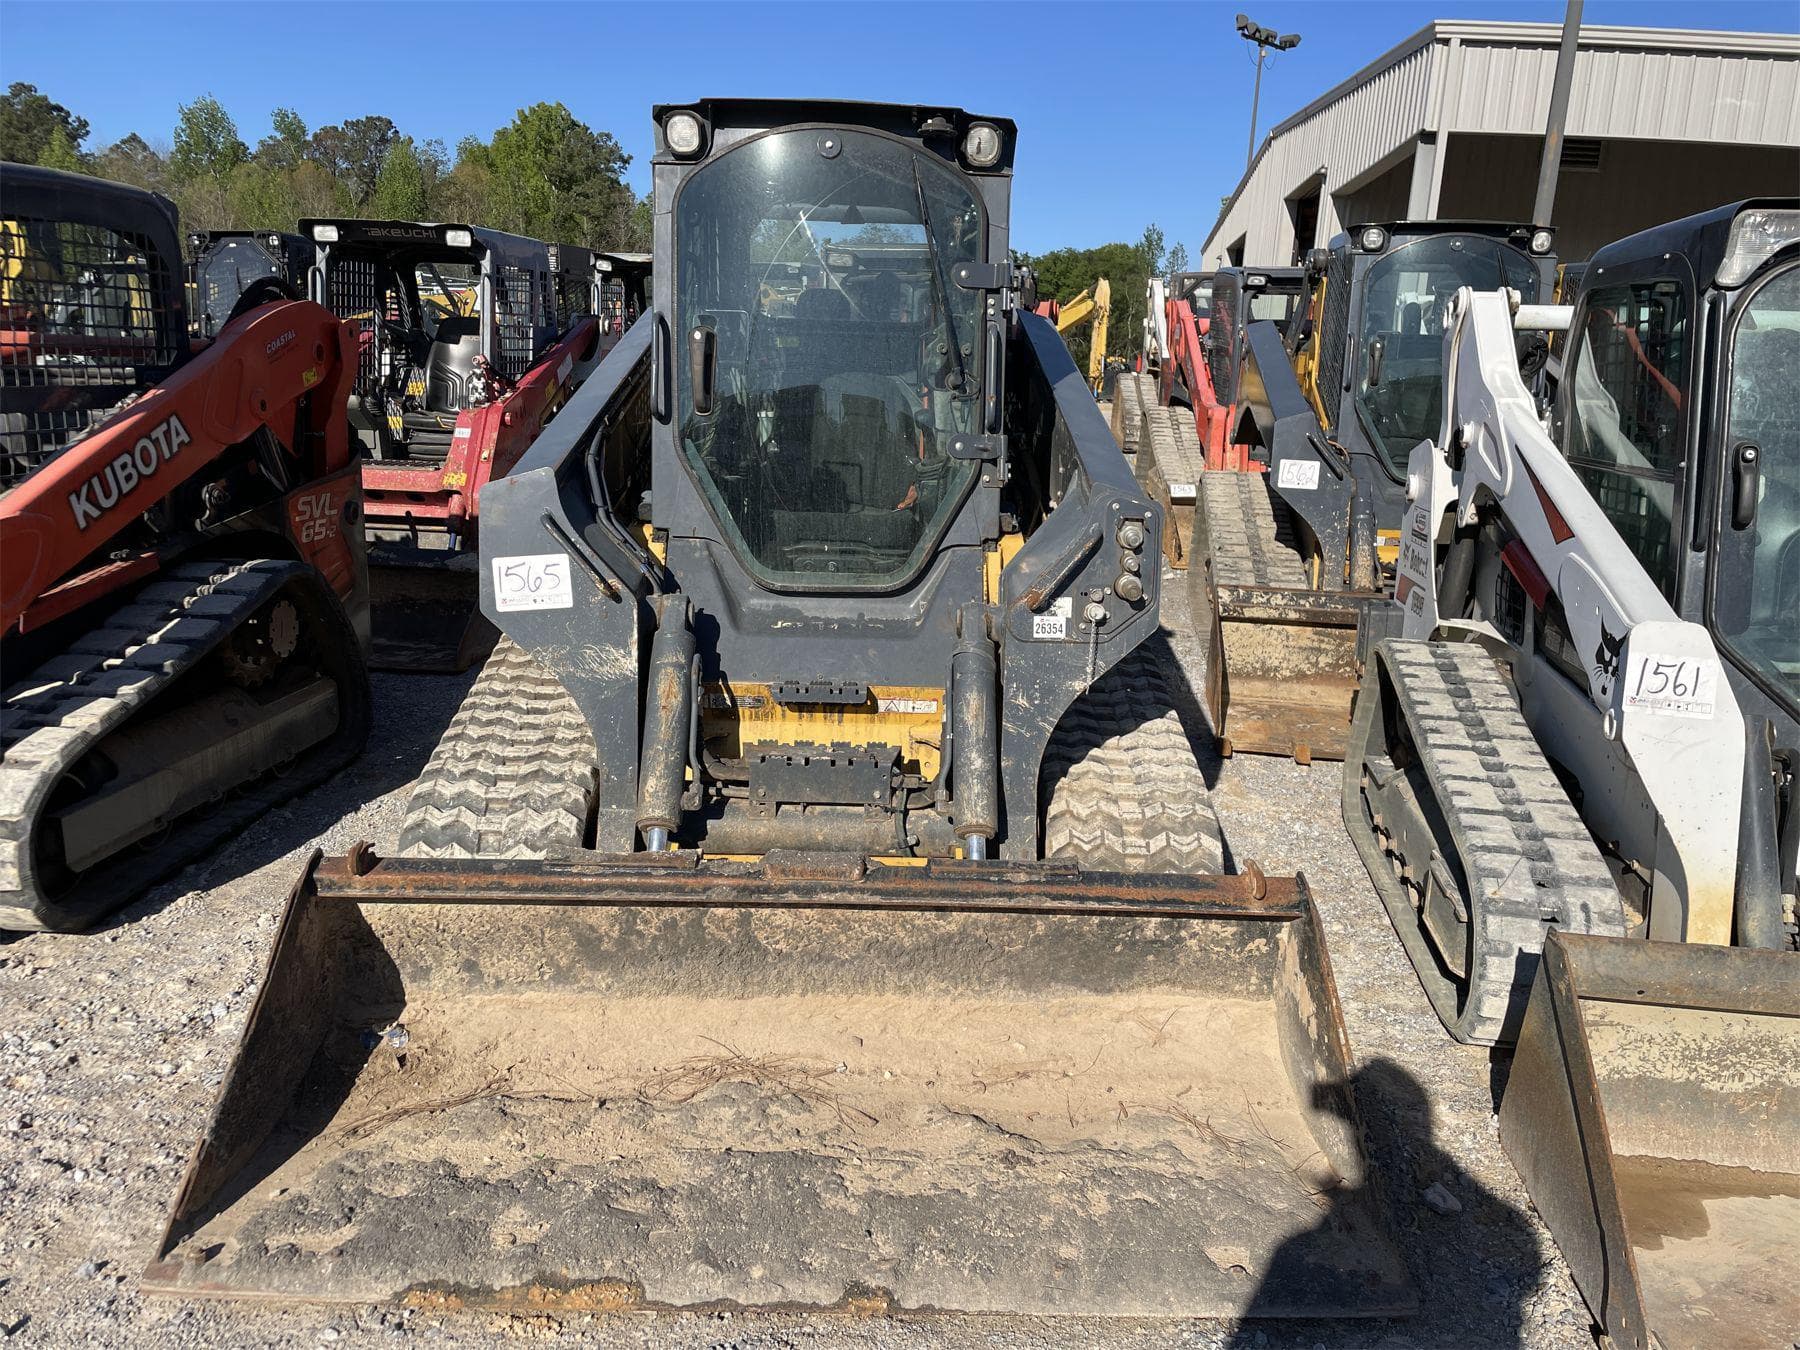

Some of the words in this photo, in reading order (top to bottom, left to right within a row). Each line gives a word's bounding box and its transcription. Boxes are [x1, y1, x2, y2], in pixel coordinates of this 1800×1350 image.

[266, 329, 297, 354] COASTAL
[68, 414, 191, 530] KUBOTA
[295, 493, 338, 521] SVL
[498, 561, 561, 593] 1565
[1035, 623, 1063, 634] 26354
[1635, 657, 1700, 697] 1561
